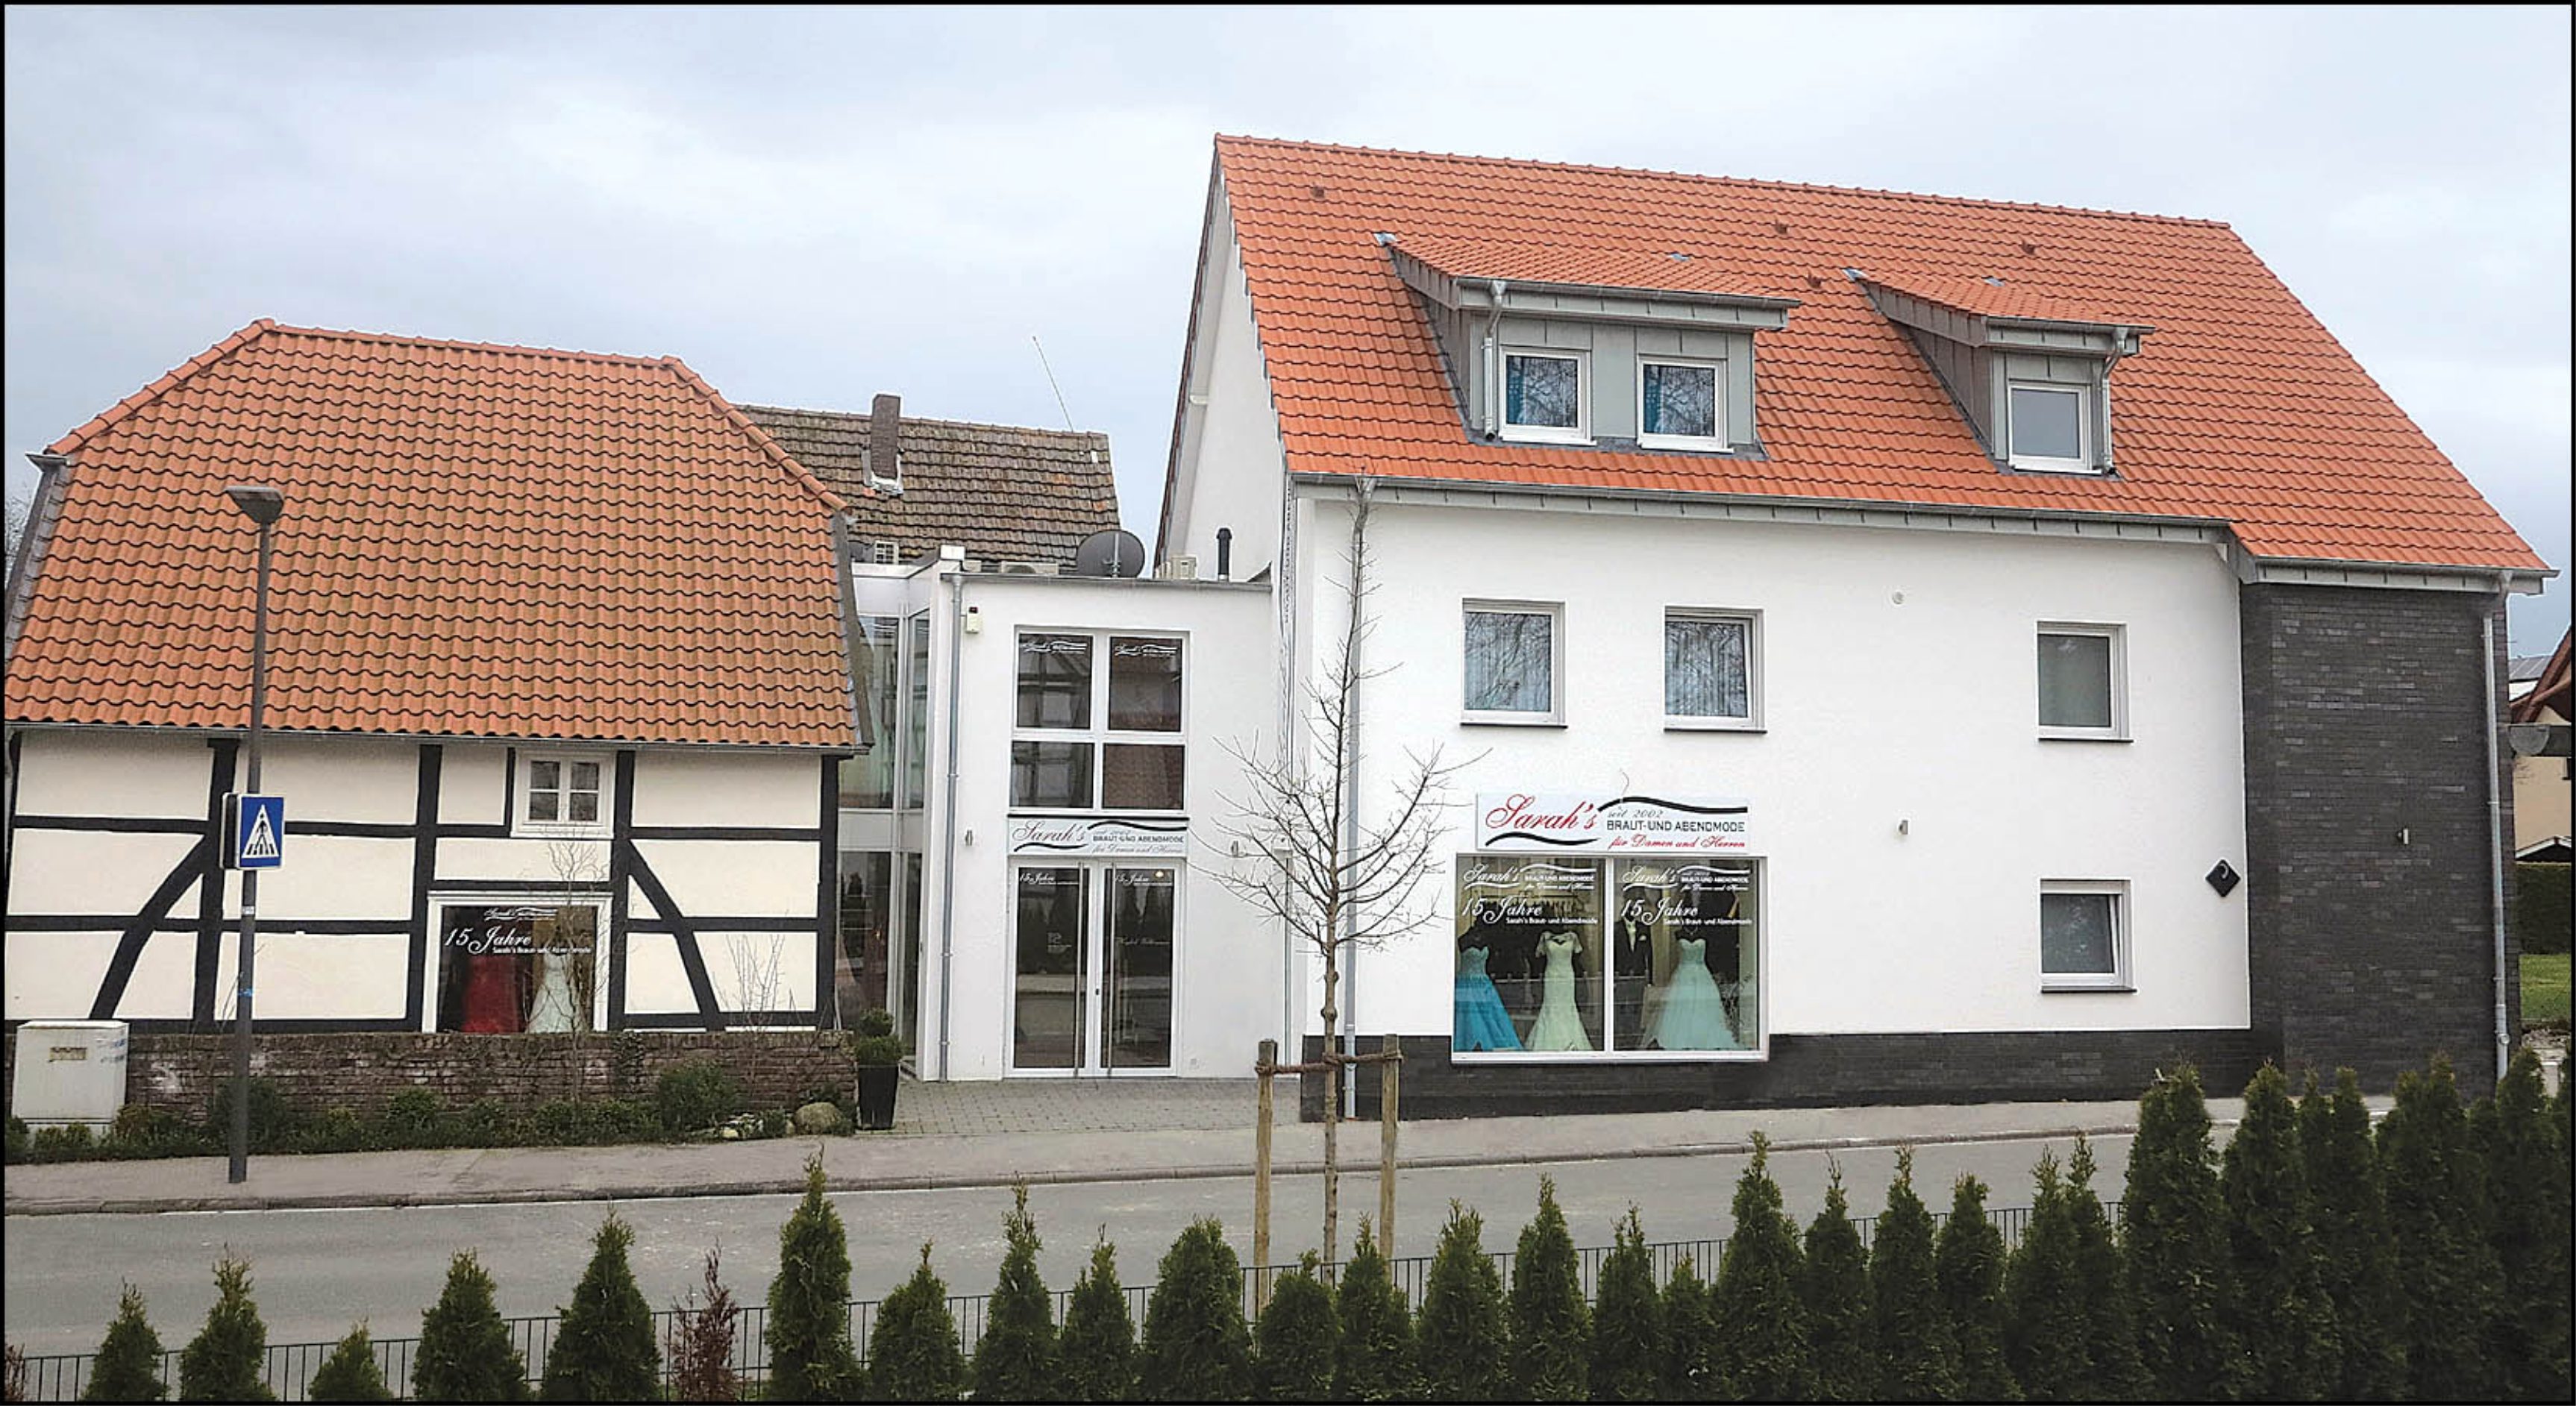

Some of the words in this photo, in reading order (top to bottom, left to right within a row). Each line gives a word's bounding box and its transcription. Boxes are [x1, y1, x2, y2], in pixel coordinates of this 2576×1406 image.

[1486, 794, 1597, 829] Sarah's
[1607, 806, 1626, 818] seit
[1632, 809, 1664, 819] 2002
[1012, 820, 1085, 842] Sarah's
[1607, 820, 1672, 831] BRAUT-UND
[1674, 821, 1745, 832] ABENDMODE
[1138, 835, 1185, 844] ABENDMODE
[1608, 836, 1628, 850] für
[1632, 834, 1673, 848] Damen
[1676, 837, 1699, 848] und
[1700, 835, 1746, 848] Herren
[1464, 864, 1519, 882] Sarah's
[1622, 865, 1677, 884] Sarah's
[1461, 897, 1488, 917] 15
[1482, 894, 1543, 925] Jahre
[1620, 899, 1646, 917] 15
[1640, 897, 1699, 926] Jahre
[1703, 917, 1716, 926] und
[444, 927, 474, 946] 15
[468, 924, 533, 955] Jahre
